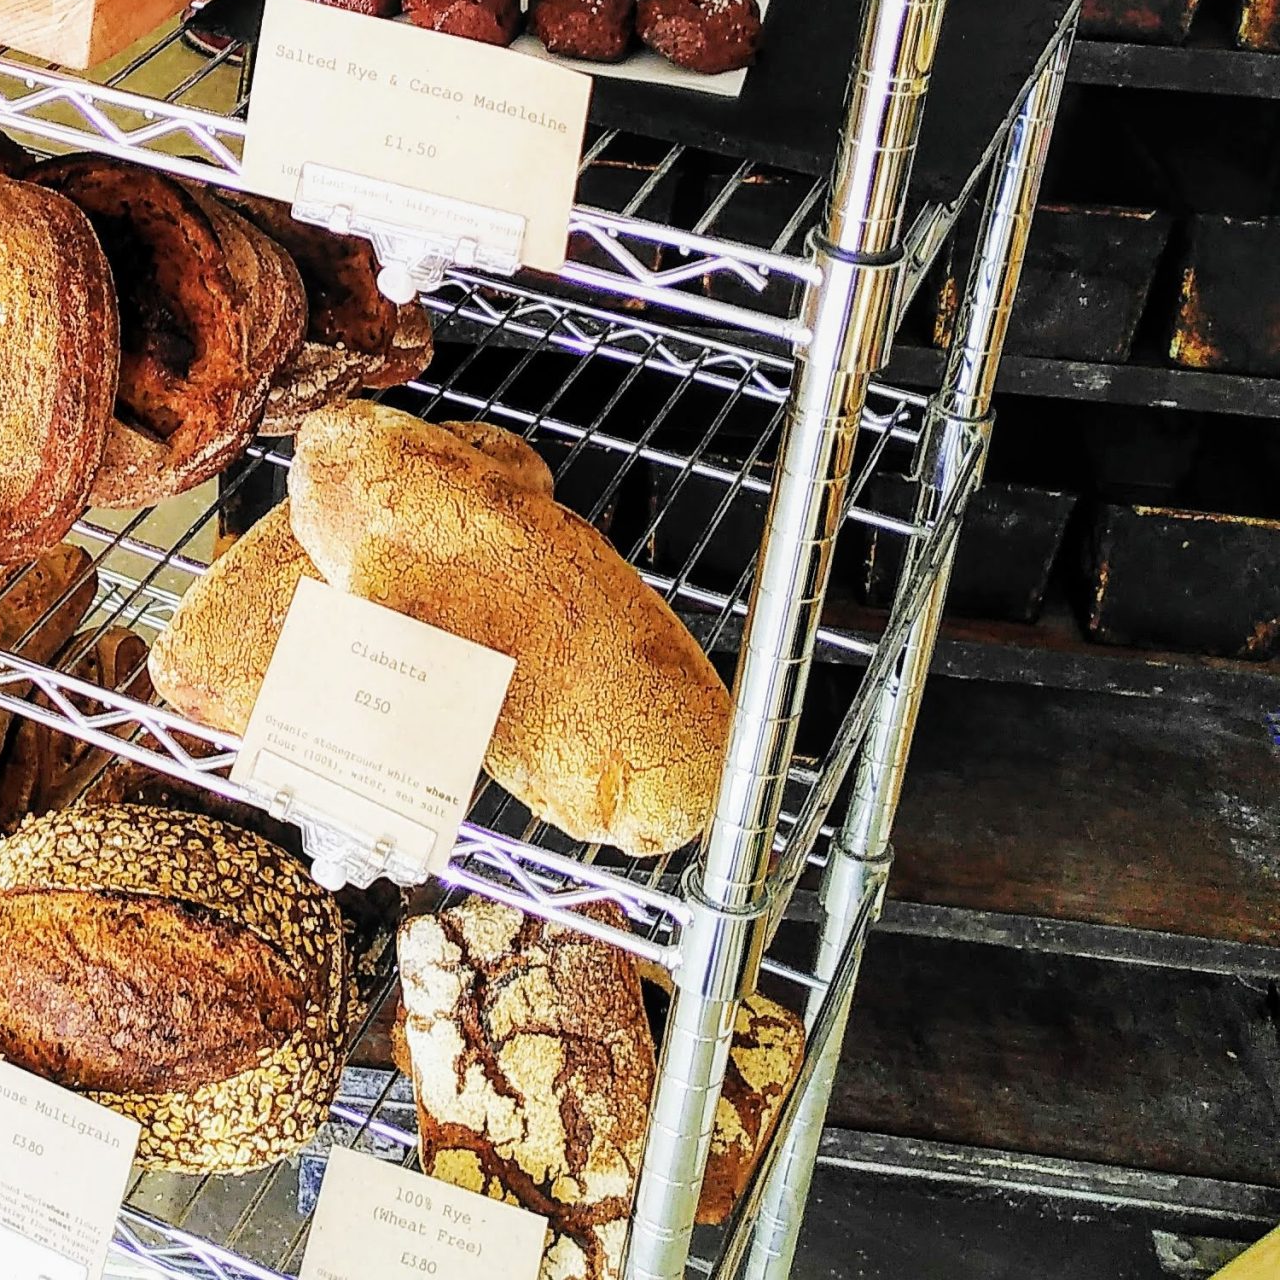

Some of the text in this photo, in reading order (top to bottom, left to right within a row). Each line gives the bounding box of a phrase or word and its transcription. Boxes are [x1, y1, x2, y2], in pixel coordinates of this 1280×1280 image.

[273, 43, 569, 135] Salted Rye & Cacao Madeleine
[383, 133, 438, 159] £1.50
[349, 640, 429, 683] Ciabatta
[265, 713, 461, 807] Organic stoneground white wheat
[266, 732, 297, 753] flour
[34, 1098, 121, 1149] Multigrain
[394, 1186, 473, 1227] 100% Rye
[372, 1205, 484, 1259] (Wheat Free)
